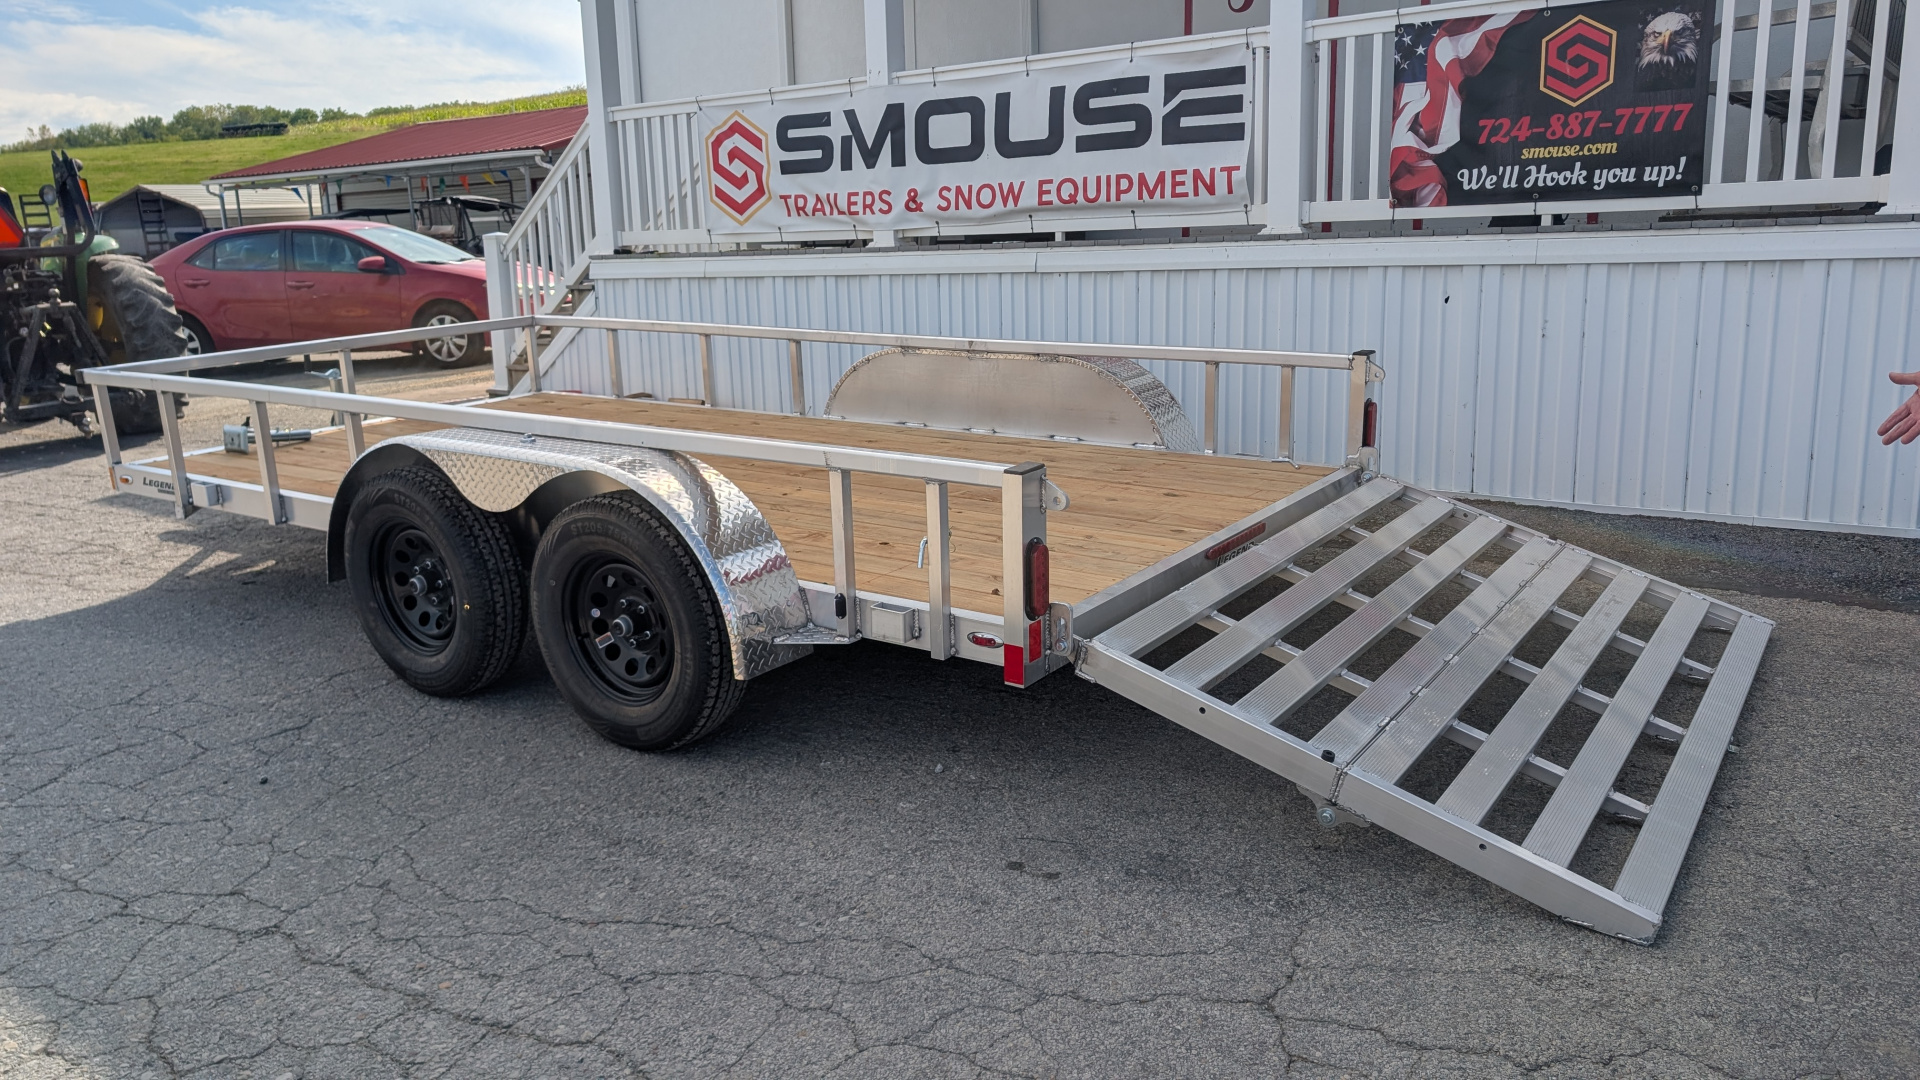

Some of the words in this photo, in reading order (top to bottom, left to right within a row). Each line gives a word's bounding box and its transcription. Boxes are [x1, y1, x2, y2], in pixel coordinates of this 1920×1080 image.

[776, 65, 1246, 175] SMOUSE
[1478, 103, 1693, 145] 724-887-7777
[1521, 142, 1617, 159] smouse.com
[779, 189, 893, 218] TRAILERS
[904, 188, 924, 213] &
[936, 181, 1026, 213] SNOW
[1037, 165, 1241, 207] EQUIPMENT
[1457, 165, 1520, 190] We'll
[1523, 161, 1587, 188] Hook
[1593, 165, 1637, 190] you
[1643, 156, 1687, 188] up!
